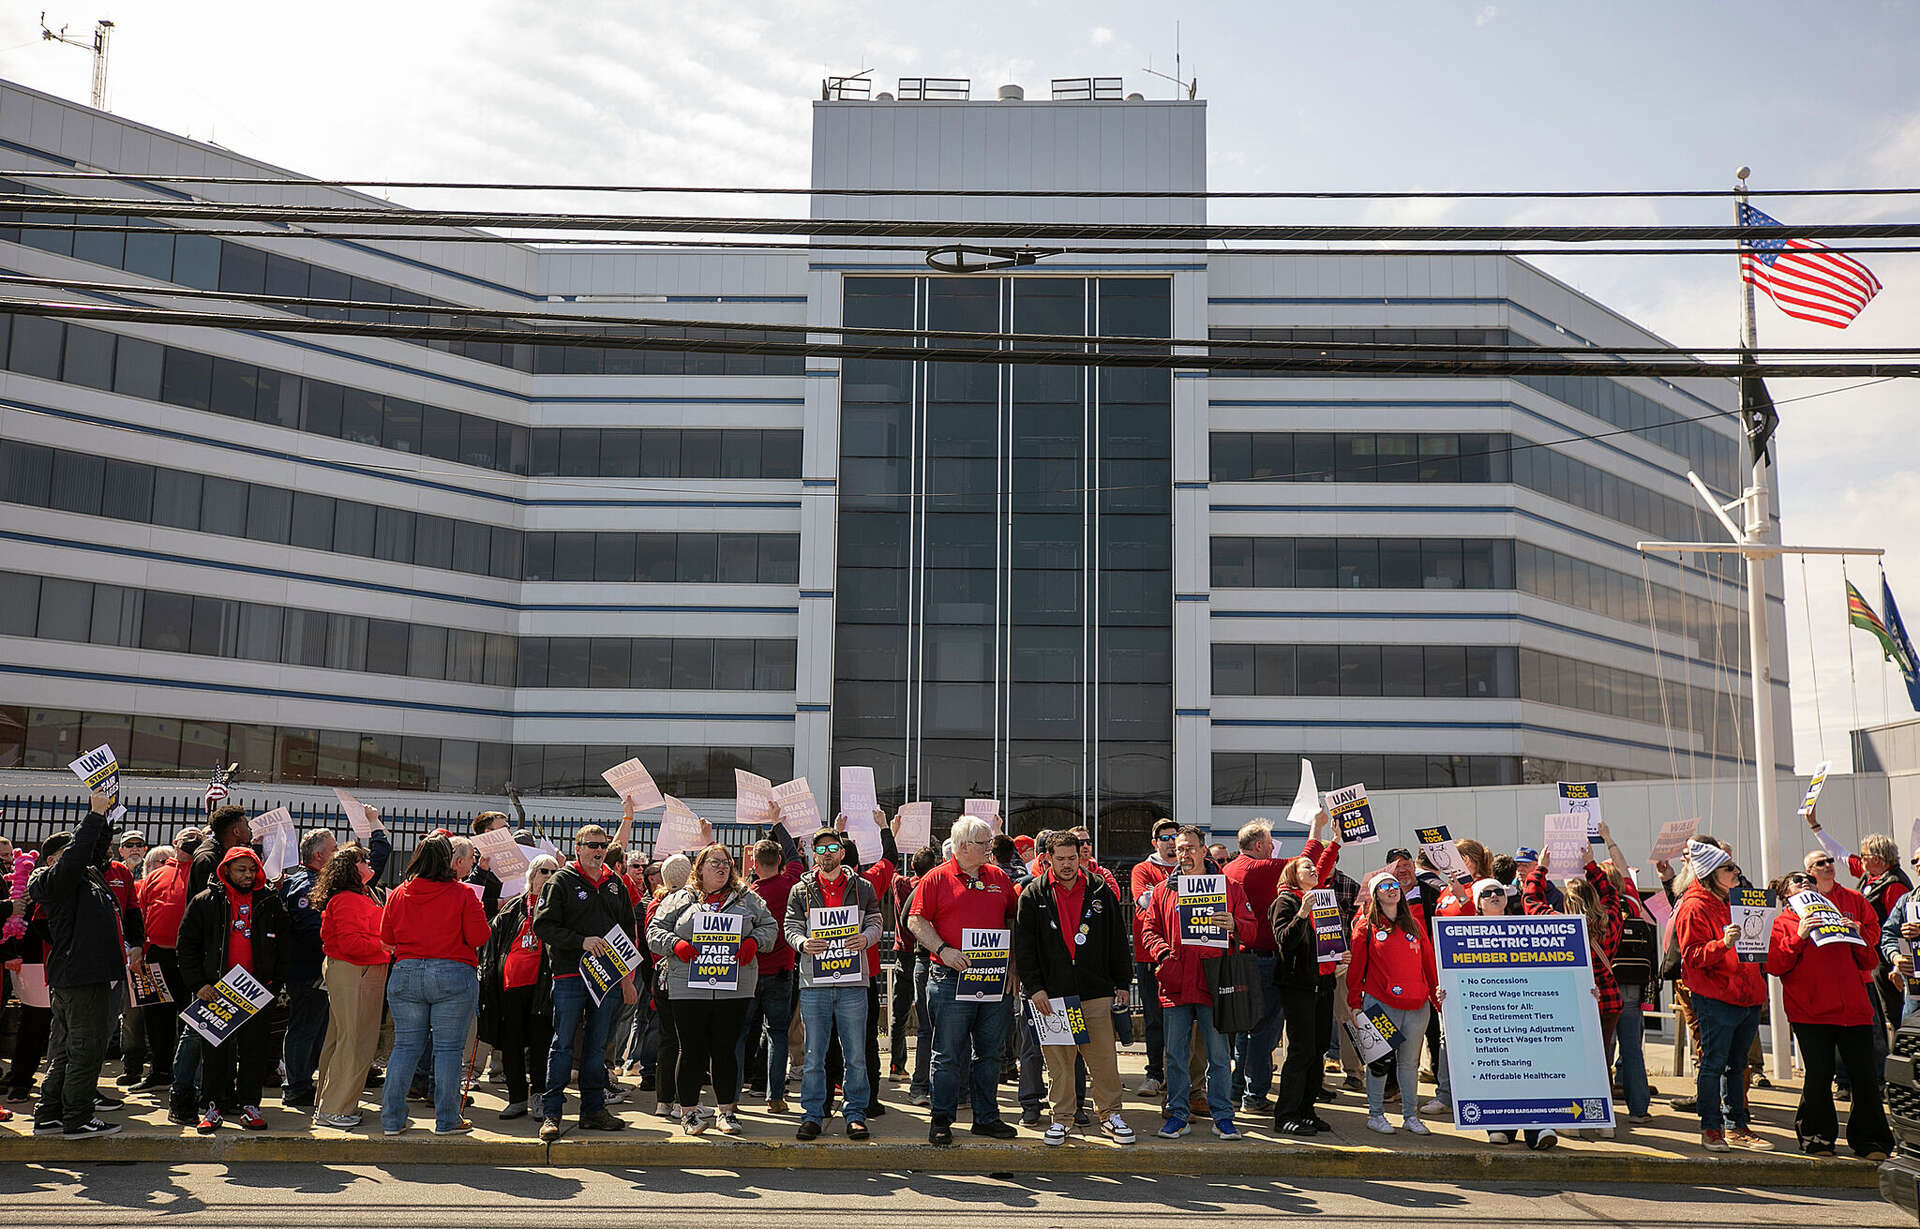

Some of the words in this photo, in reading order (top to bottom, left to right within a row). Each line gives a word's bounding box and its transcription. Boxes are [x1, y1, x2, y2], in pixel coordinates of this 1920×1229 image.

[80, 750, 108, 772] UAW
[89, 769, 110, 784] STAND
[1333, 789, 1356, 805] UAW
[1333, 803, 1354, 814] STAND
[1343, 810, 1361, 820] IT'S
[1344, 818, 1365, 828] OUR
[1344, 825, 1370, 837] TIME!
[1424, 835, 1443, 843] TOCK
[1188, 879, 1216, 893] UAW
[1742, 890, 1765, 898] TICK
[1741, 898, 1767, 906] TOCK
[1192, 907, 1215, 916] IT'S
[703, 916, 733, 931] UAW
[820, 910, 849, 926] UAW
[1188, 926, 1220, 934] TIME!
[1445, 926, 1505, 936] GENERAL
[1508, 924, 1576, 935] DYNAMICS
[1819, 926, 1849, 935] NOW
[972, 933, 1001, 947] UAW
[1467, 938, 1529, 949] ELECTRIC
[1531, 937, 1566, 947] BOAT
[613, 934, 636, 961] UAW
[702, 945, 729, 954] FAIR
[1453, 952, 1507, 963] MEMBER
[1510, 951, 1575, 962] DEMANDS
[589, 956, 611, 982] PROFIT
[618, 963, 627, 973] UP
[698, 966, 729, 975] NOW
[821, 959, 852, 970] NOW
[582, 957, 608, 991] SHARING
[153, 971, 168, 995] UAW
[232, 973, 264, 1001] UAW
[1481, 977, 1528, 985] Concessions
[219, 984, 243, 1003] STAND
[243, 1003, 254, 1012] UP
[1469, 990, 1497, 998] Record
[1499, 990, 1520, 999] Wage
[208, 1002, 232, 1021] OUR
[216, 998, 238, 1014] IT'S
[197, 1006, 228, 1031] TIME!
[1067, 1007, 1079, 1034] TOCK
[1075, 1008, 1086, 1031] TICK
[1534, 1012, 1554, 1020] Tiers
[1372, 1016, 1392, 1040] TOCK
[1379, 1013, 1397, 1034] TICK
[1503, 1026, 1527, 1034] Living
[1530, 1025, 1575, 1034] Adjustment
[1516, 1035, 1542, 1043] Wages
[1478, 1059, 1500, 1067] Profit
[1502, 1059, 1532, 1067] Sharing
[1479, 1072, 1521, 1080] Affordable
[1524, 1072, 1566, 1080] Healthcare
